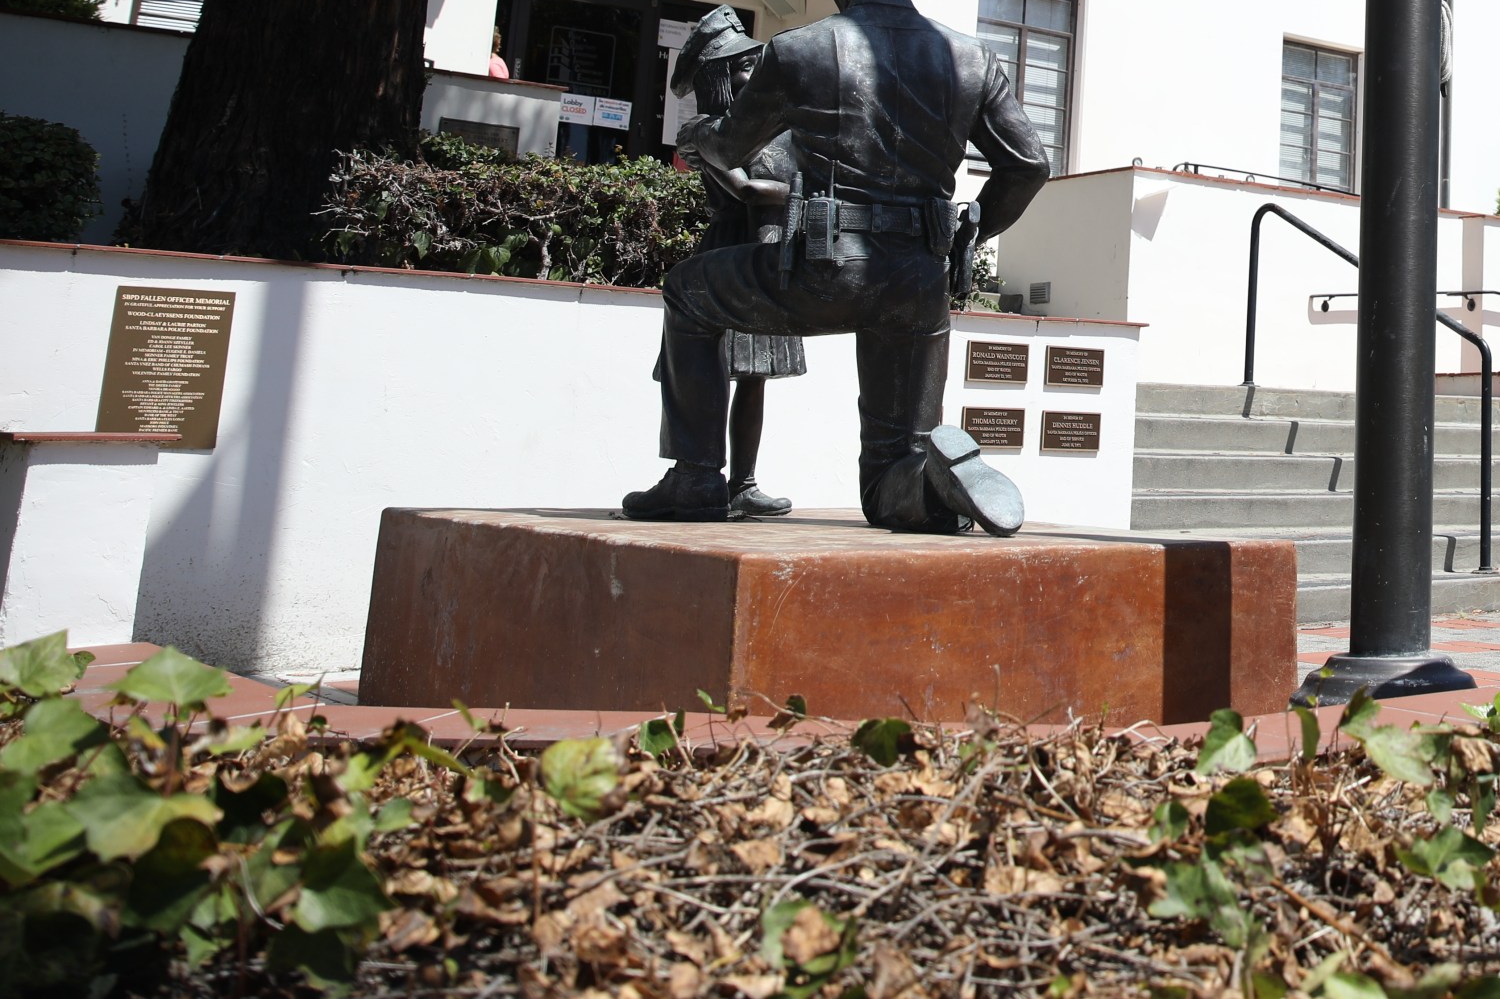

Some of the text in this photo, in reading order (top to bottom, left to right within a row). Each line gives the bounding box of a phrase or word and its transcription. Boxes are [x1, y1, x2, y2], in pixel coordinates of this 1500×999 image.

[564, 98, 582, 106] Lobby
[562, 106, 586, 114] CLOSED
[167, 296, 194, 304] OFFICER
